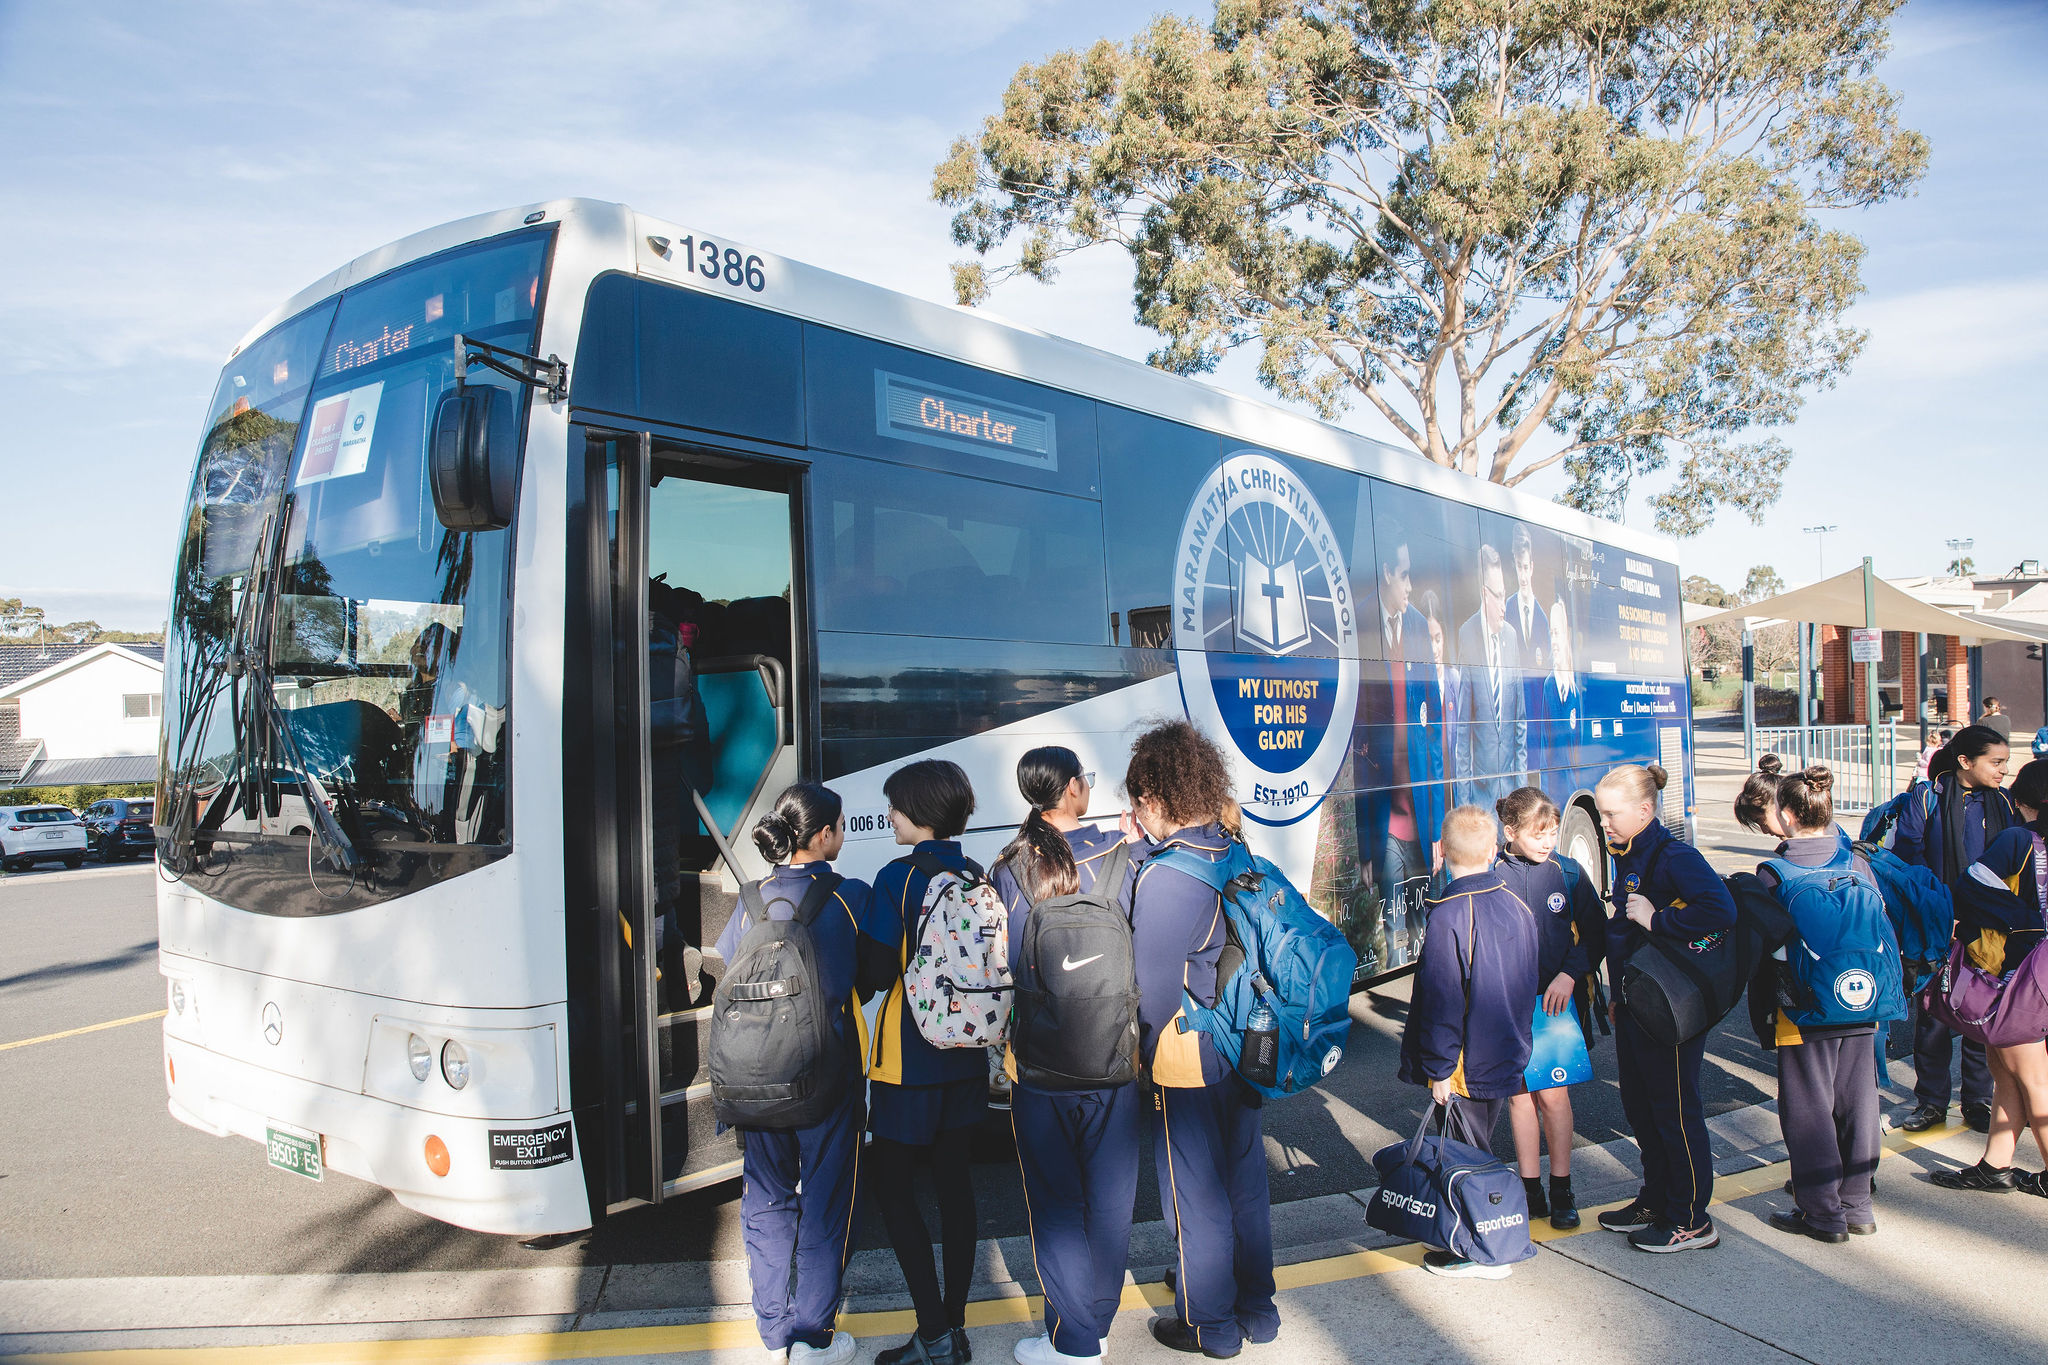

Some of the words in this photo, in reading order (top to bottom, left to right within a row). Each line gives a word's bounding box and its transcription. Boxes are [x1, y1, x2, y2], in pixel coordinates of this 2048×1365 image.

[680, 234, 765, 292] 1386
[336, 325, 414, 372] Charter
[920, 397, 1017, 444] Charter
[1182, 475, 1239, 632] MARANATHA
[1241, 468, 1319, 534] CHRISTIAN
[1319, 533, 1352, 644] SCHOOL
[1239, 678, 1261, 698] MY
[1263, 679, 1319, 699] UTMOST
[1254, 704, 1283, 725] FOR
[1285, 704, 1307, 724] HIS
[1258, 730, 1304, 750] GLORY
[1254, 783, 1280, 806] EST.
[1282, 780, 1309, 805] 1970
[850, 815, 874, 832] 006
[2035, 849, 2047, 875] PINK
[493, 1127, 567, 1146] EMERGENCY
[271, 1140, 299, 1168] BS03
[303, 1150, 320, 1175] ES
[516, 1145, 546, 1158] EXIT
[532, 1156, 552, 1165] UNDER
[552, 1152, 569, 1161] PANEL
[1381, 1188, 1437, 1218] sportsco
[1476, 1212, 1524, 1236] sportsco
